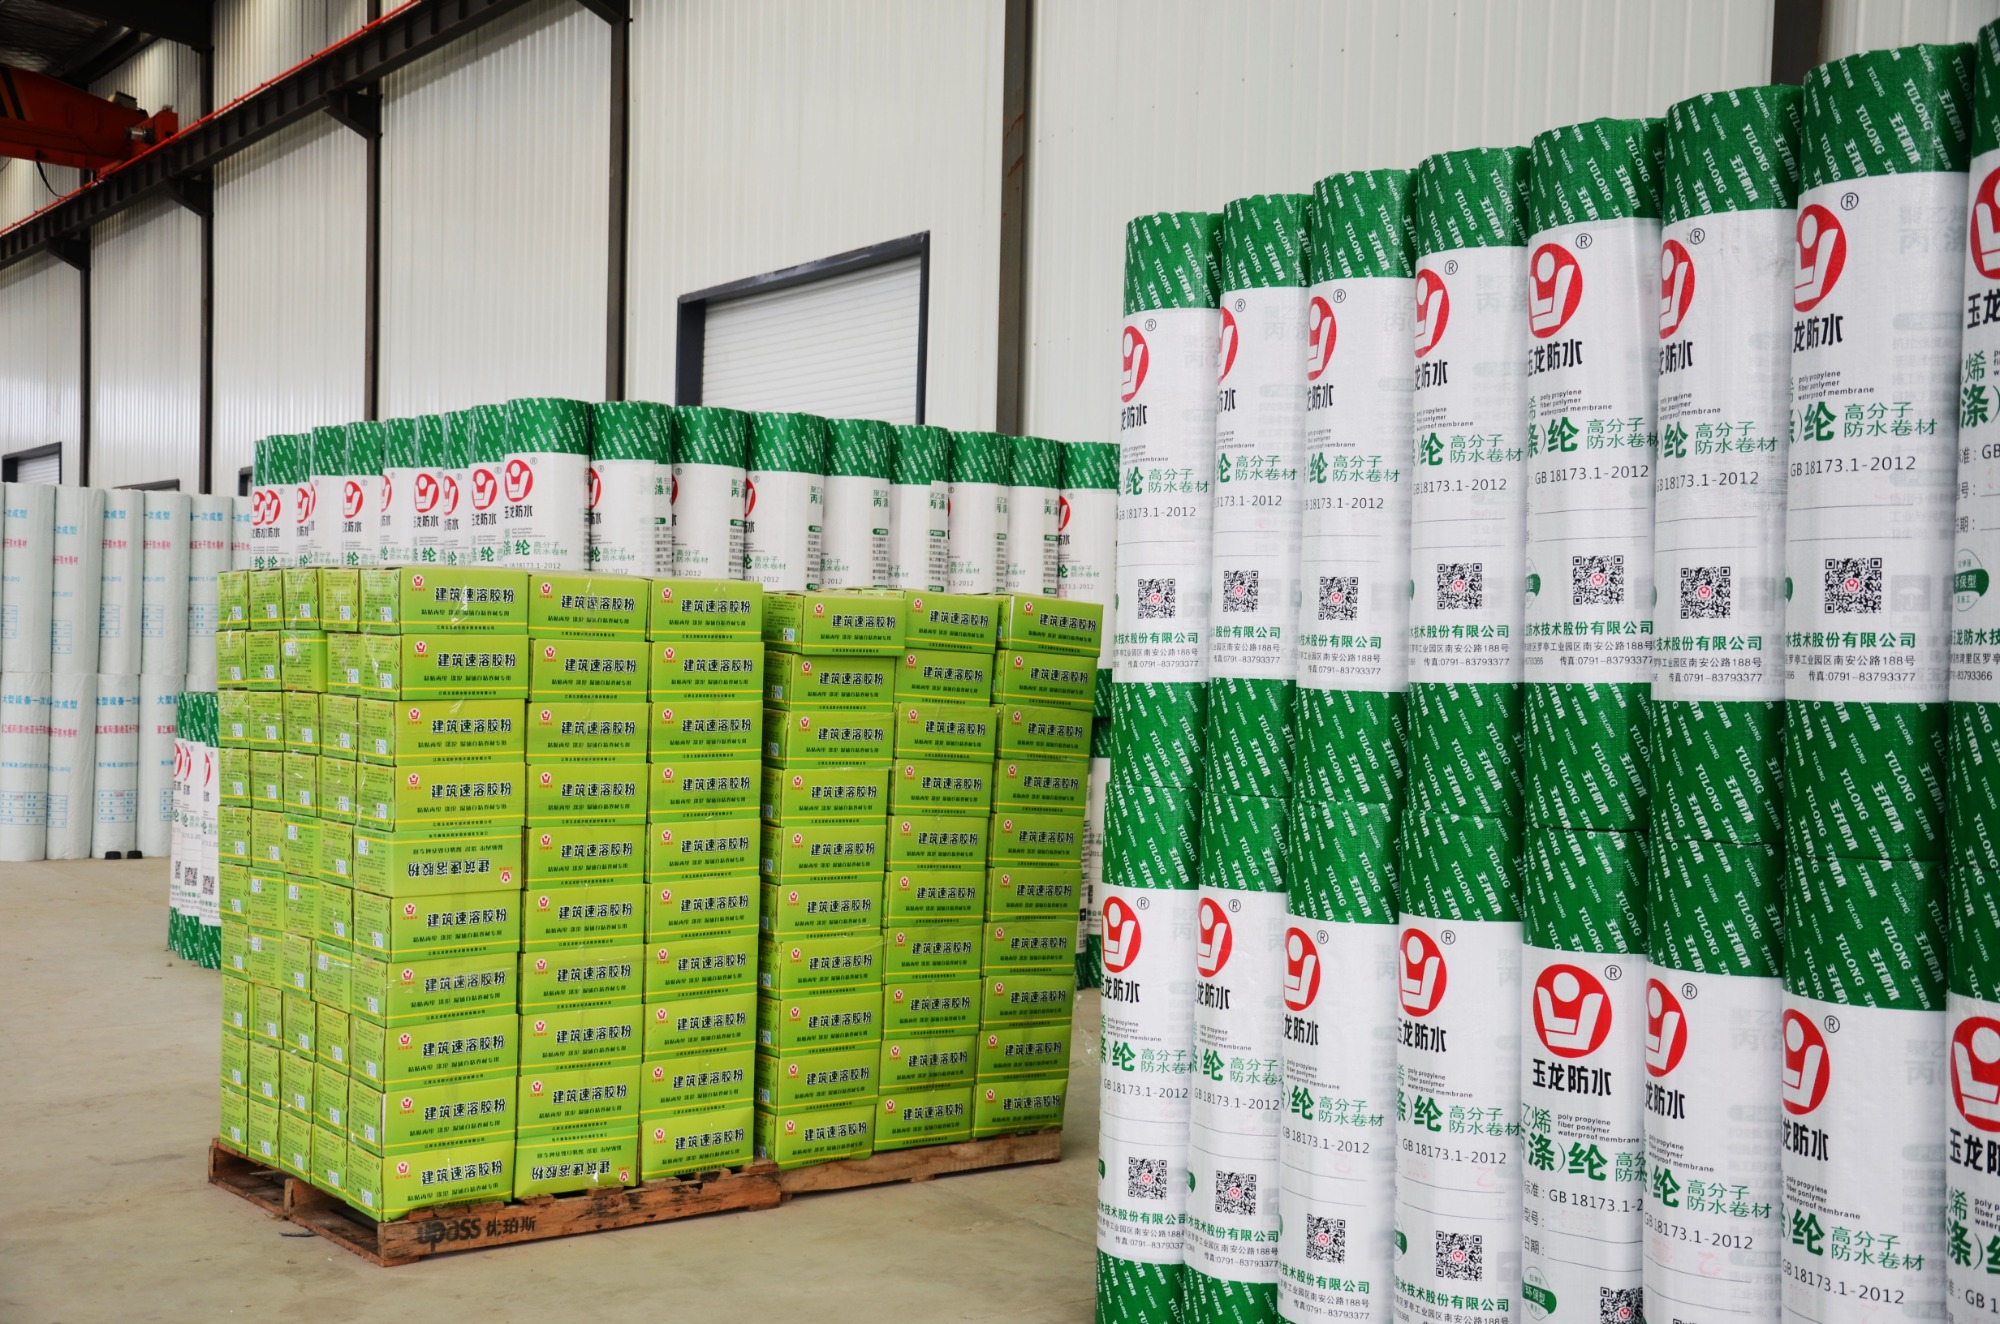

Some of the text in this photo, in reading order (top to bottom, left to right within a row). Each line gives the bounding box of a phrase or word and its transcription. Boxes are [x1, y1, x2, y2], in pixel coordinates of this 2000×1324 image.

[1867, 66, 1885, 98] YULONG
[1903, 78, 1934, 131] YULONG
[1856, 104, 1885, 155] YULONG
[1742, 123, 1770, 172] YULONG
[1793, 313, 1843, 353] 龙防水
[1570, 403, 1613, 411] membrane
[1844, 402, 1914, 421] 高分子
[1587, 418, 1646, 433] 高分子
[1695, 421, 1756, 438] 高分子
[1844, 418, 1938, 438] 防水卷材
[1451, 434, 1504, 448] 高分子
[1586, 432, 1659, 449] 防水卷材
[1695, 436, 1778, 455] 防水卷材
[1236, 455, 1281, 468] 高分子
[1333, 455, 1383, 468] 高分子
[1450, 448, 1523, 463] 防水卷材
[1148, 468, 1194, 481] 高分子
[1235, 468, 1298, 481] 防水卷材
[1333, 469, 1400, 482] 防水卷材
[1148, 481, 1210, 493] 防水卷材
[435, 587, 515, 603] 建筑速溶胶粉
[561, 595, 635, 611] 建筑速溶胶粉
[832, 615, 895, 628] 建筑速溶胶粉
[1040, 614, 1096, 631] 建筑速溶胶粉
[437, 653, 516, 667] 建筑速溶胶粉
[683, 659, 753, 673] 建筑速溶胶粉
[923, 666, 983, 681] 建筑速溶胶粉
[432, 719, 512, 733] 建筑速溶胶粉
[561, 721, 635, 735] 建筑速溶胶粉
[818, 728, 884, 741] 建筑速溶胶粉
[1178, 716, 1200, 753] YULONG
[1356, 728, 1379, 770] YULONG
[1591, 741, 1618, 788] YULONG
[682, 776, 751, 791] 建筑速溶胶粉
[1883, 750, 1916, 802] YULONG
[917, 886, 976, 900] 建筑速溶胶粉
[427, 908, 507, 928] 建筑速溶胶粉
[1011, 937, 1067, 949] 建筑速溶胶粉
[1880, 917, 1912, 971] YULONG
[809, 954, 873, 970] 建筑速溶胶粉
[425, 972, 506, 993] 建筑速溶胶粉
[677, 1012, 746, 1031] 建筑速溶胶粉
[422, 1034, 505, 1058] 建筑速溶胶粉
[1141, 1048, 1187, 1061] 高分子
[1230, 1057, 1278, 1071] 高分子
[1532, 1057, 1612, 1096] 玉龙防水
[552, 1085, 628, 1105] 建筑速溶胶粉
[1003, 1095, 1060, 1111] 建筑速溶胶粉
[903, 1103, 964, 1121] 建筑速溶胶粉
[1319, 1096, 1368, 1112] 高分子
[1318, 1109, 1384, 1127] 防水卷材
[1449, 1106, 1503, 1121] 高分子
[1558, 1113, 1611, 1126] poly propylene
[804, 1122, 867, 1141] 建筑速溶胶粉
[1449, 1119, 1521, 1136] 防水卷材
[1558, 1121, 1573, 1131] fiber
[674, 1128, 744, 1151] 建筑速溶胶粉
[1558, 1129, 1640, 1145] waterproof membrane
[421, 1160, 503, 1185] 建筑速溶胶粉
[1549, 1189, 1567, 1204] GB
[1687, 1179, 1750, 1201] 高分子
[1686, 1195, 1772, 1219] 防水卷材
[1831, 1226, 1901, 1251] 高分子
[1831, 1244, 1925, 1271] 防水卷材
